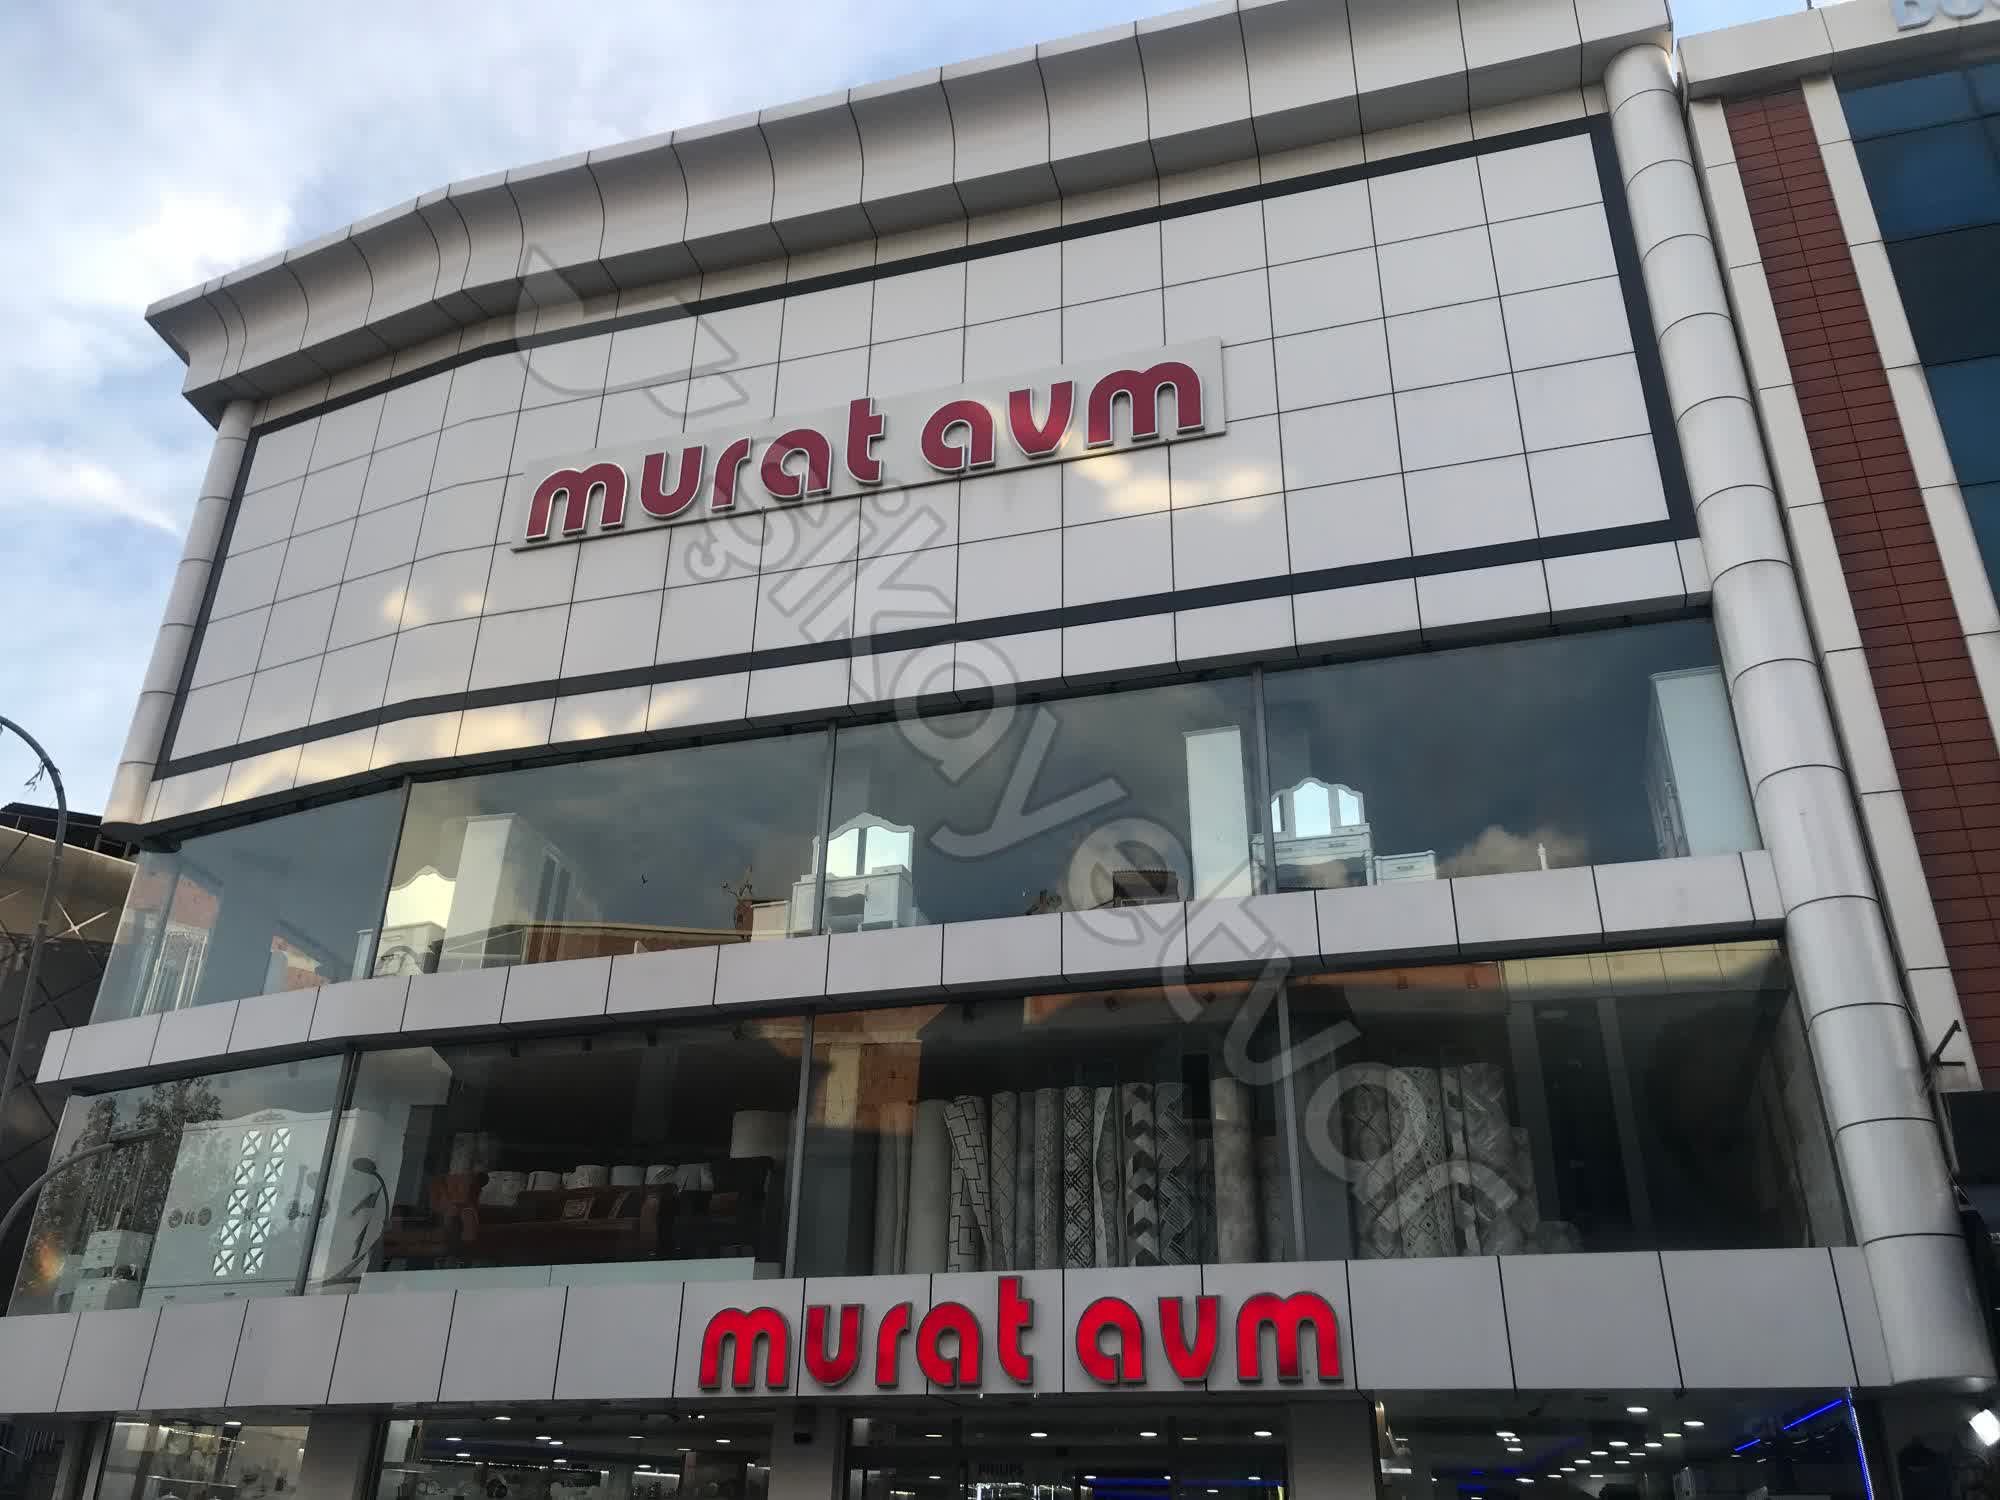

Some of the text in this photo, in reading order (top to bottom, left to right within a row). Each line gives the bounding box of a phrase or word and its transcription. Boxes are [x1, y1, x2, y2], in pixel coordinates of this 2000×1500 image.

[525, 361, 1206, 541] murat avm
[698, 1276, 1344, 1390] murat avm
